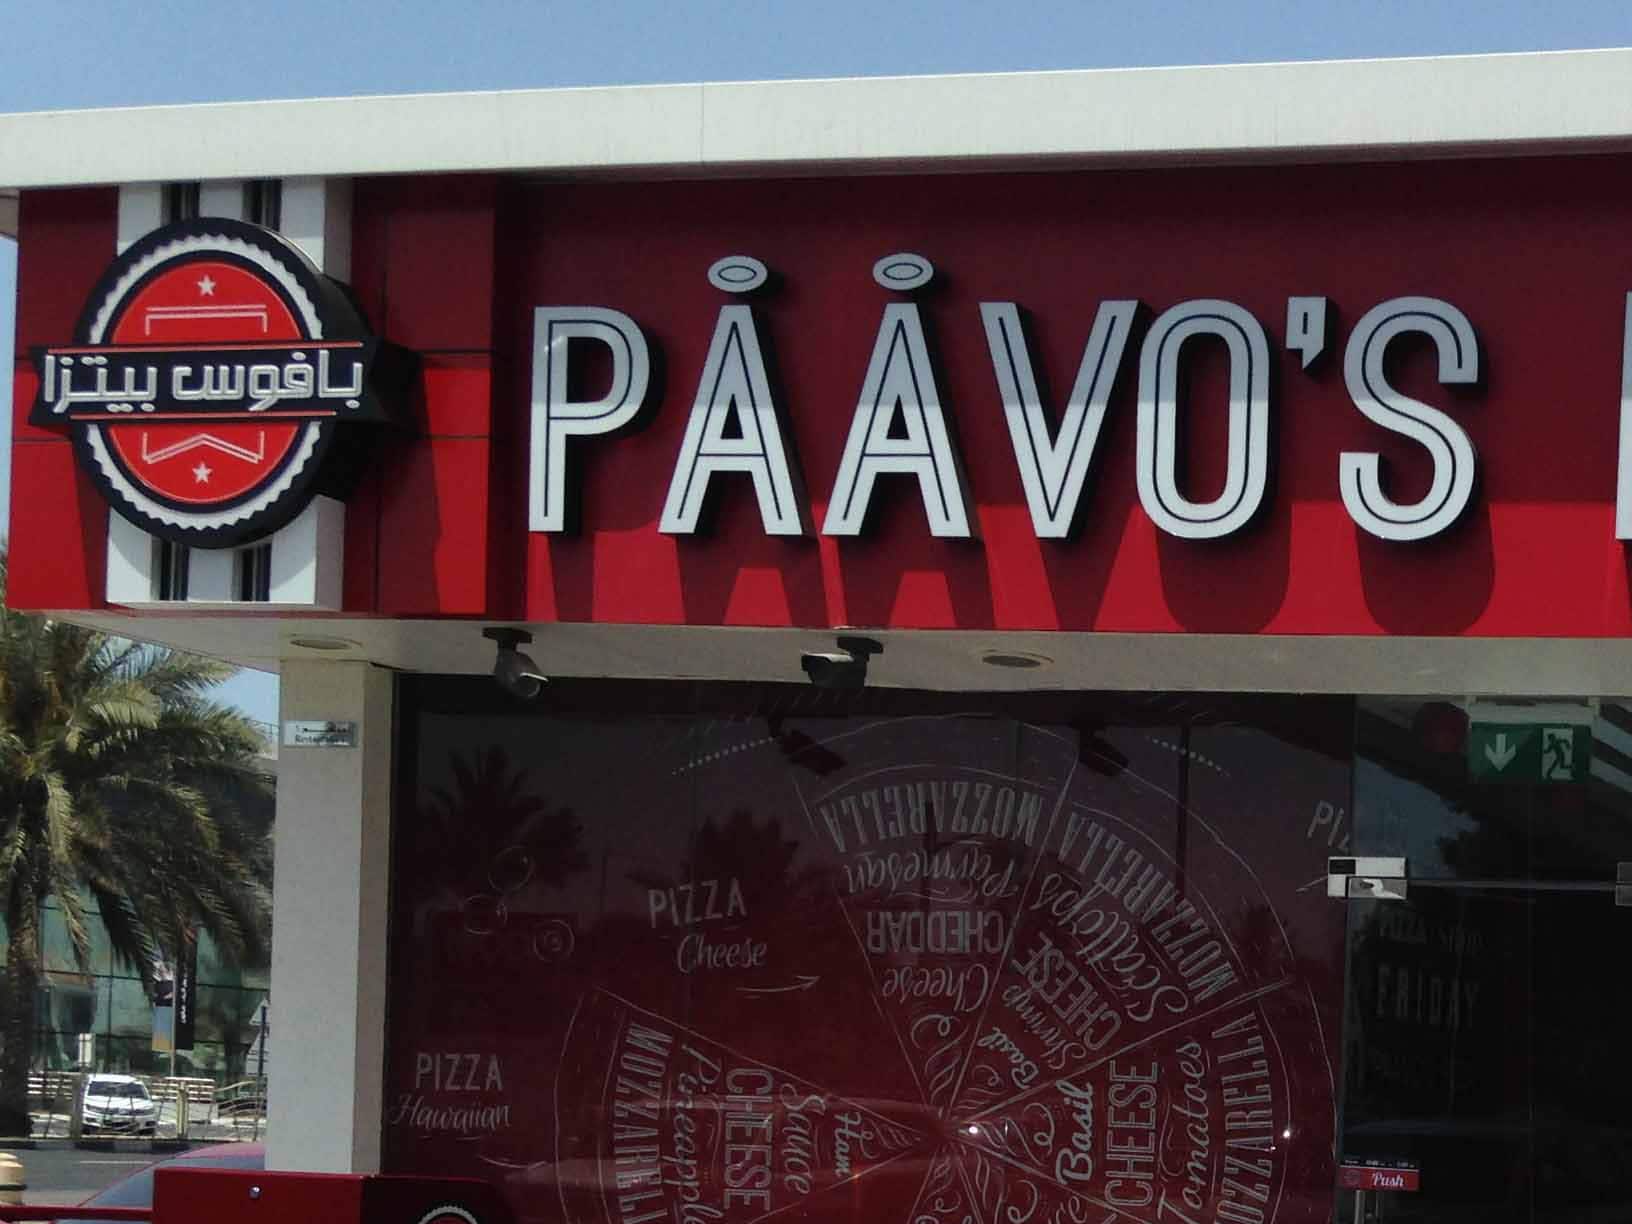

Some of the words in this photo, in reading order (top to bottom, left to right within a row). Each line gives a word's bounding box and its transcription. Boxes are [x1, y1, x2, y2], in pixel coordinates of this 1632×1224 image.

[44, 353, 158, 413] بيتزا
[172, 350, 364, 412] بافوس
[528, 252, 1480, 542] PÅÅVO'S
[819, 779, 1042, 854] MOZZARELLA
[648, 878, 748, 929] PIZZA
[843, 850, 1019, 897] Parmesan
[866, 911, 1004, 953] CHEDDAR
[1058, 813, 1239, 1005] MOZZARELLA
[677, 934, 768, 974] Cheese
[882, 963, 989, 1013] Cheese
[1012, 931, 1122, 1051] CHEESE
[415, 1052, 504, 1092] PIZZA
[977, 1027, 1039, 1089] Basil
[389, 1093, 511, 1136] Hawaiian
[723, 1068, 775, 1212] CHEESE
[779, 1082, 827, 1196] Sauce
[832, 1111, 867, 1178] Ham
[1055, 1079, 1093, 1186] Basil
[1104, 1059, 1158, 1206] CHEESE
[1371, 1172, 1405, 1188] Push
